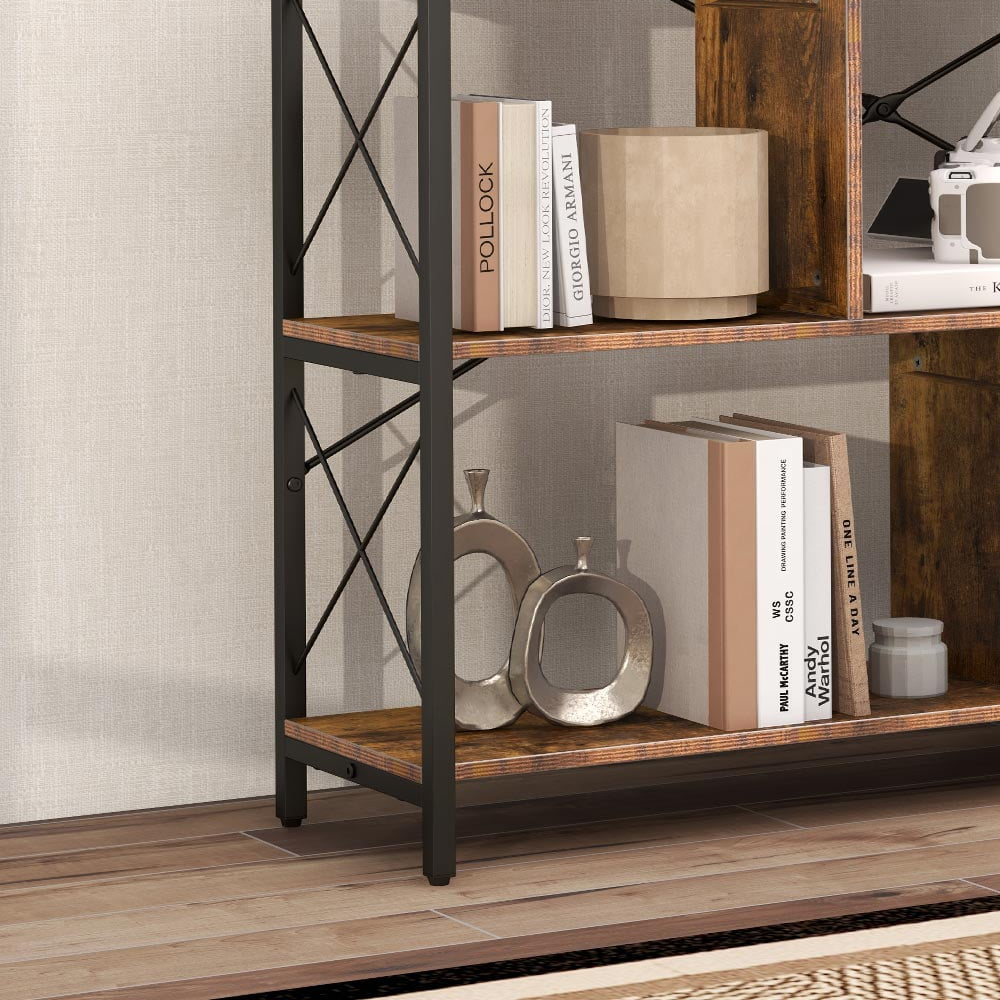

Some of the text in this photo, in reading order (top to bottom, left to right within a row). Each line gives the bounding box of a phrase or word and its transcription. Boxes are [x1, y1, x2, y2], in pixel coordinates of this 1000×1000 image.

[541, 108, 550, 199] REVOLUTION
[478, 162, 495, 273] POLLOCK
[541, 204, 550, 244] LOOK
[561, 152, 584, 301] GIORGIO ARMANI
[541, 248, 550, 280] NEW
[771, 600, 781, 619] WS
[784, 590, 794, 622] CSSC
[842, 519, 860, 636] ONE LINE A DAY
[779, 643, 789, 712] PAUL McCARTHY
[804, 645, 819, 698] Andy
[817, 635, 830, 706] Warhol
